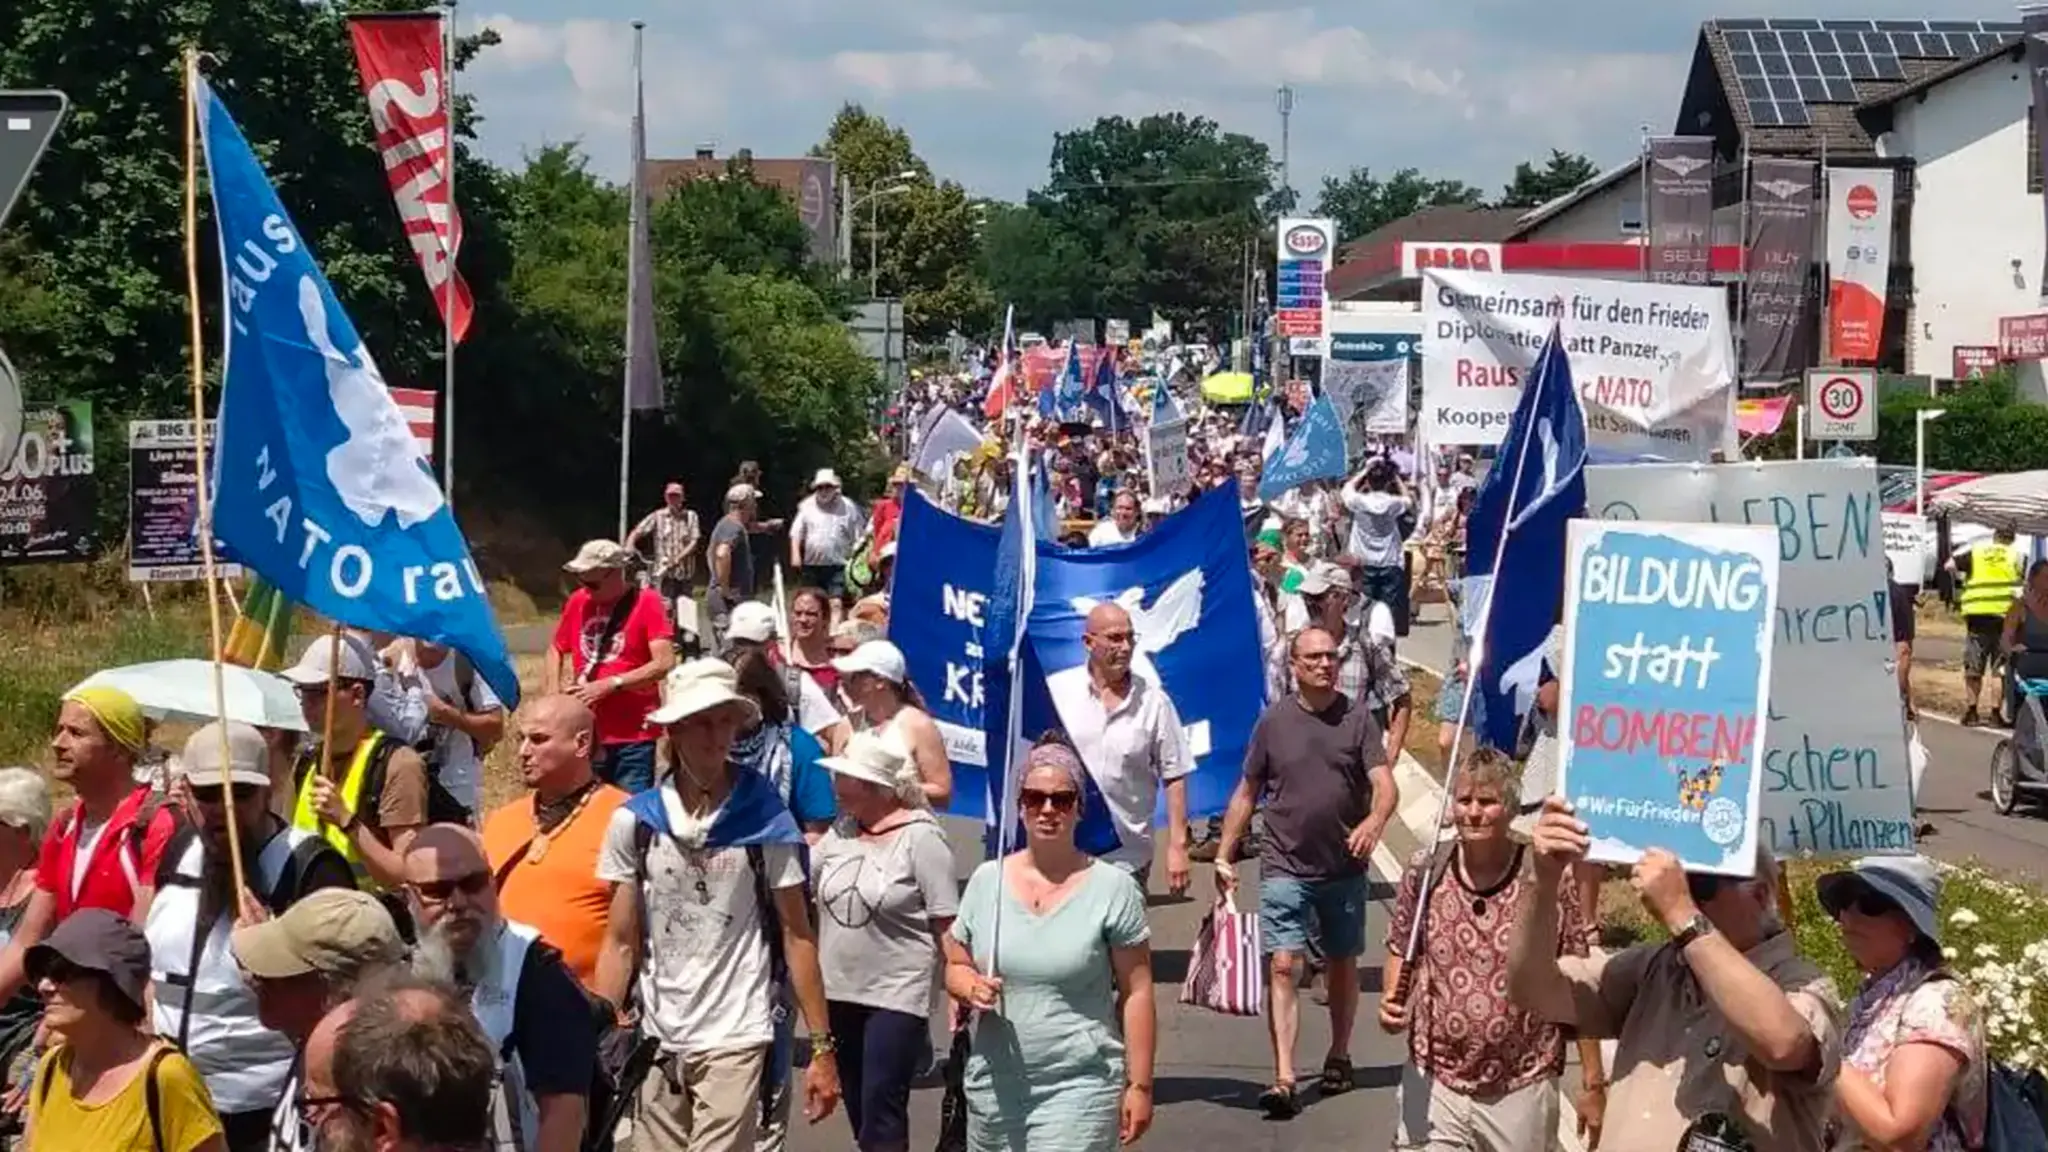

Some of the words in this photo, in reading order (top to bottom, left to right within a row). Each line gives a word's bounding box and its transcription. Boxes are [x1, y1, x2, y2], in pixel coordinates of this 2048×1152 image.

[1291, 231, 1321, 248] Esso
[1437, 285, 1565, 318] Gemeinsam
[1571, 295, 1602, 321] für
[1607, 298, 1643, 324] den
[1649, 303, 1710, 331] Frieden
[1456, 357, 1520, 388] Raus
[1594, 375, 1653, 409] NATO
[1829, 388, 1854, 409] 30
[157, 423, 184, 437] BIG
[256, 443, 374, 599] NATO
[1583, 552, 1761, 612] BILDUNG
[1604, 631, 1721, 690] statt
[1575, 704, 1757, 766] BOMBEN!
